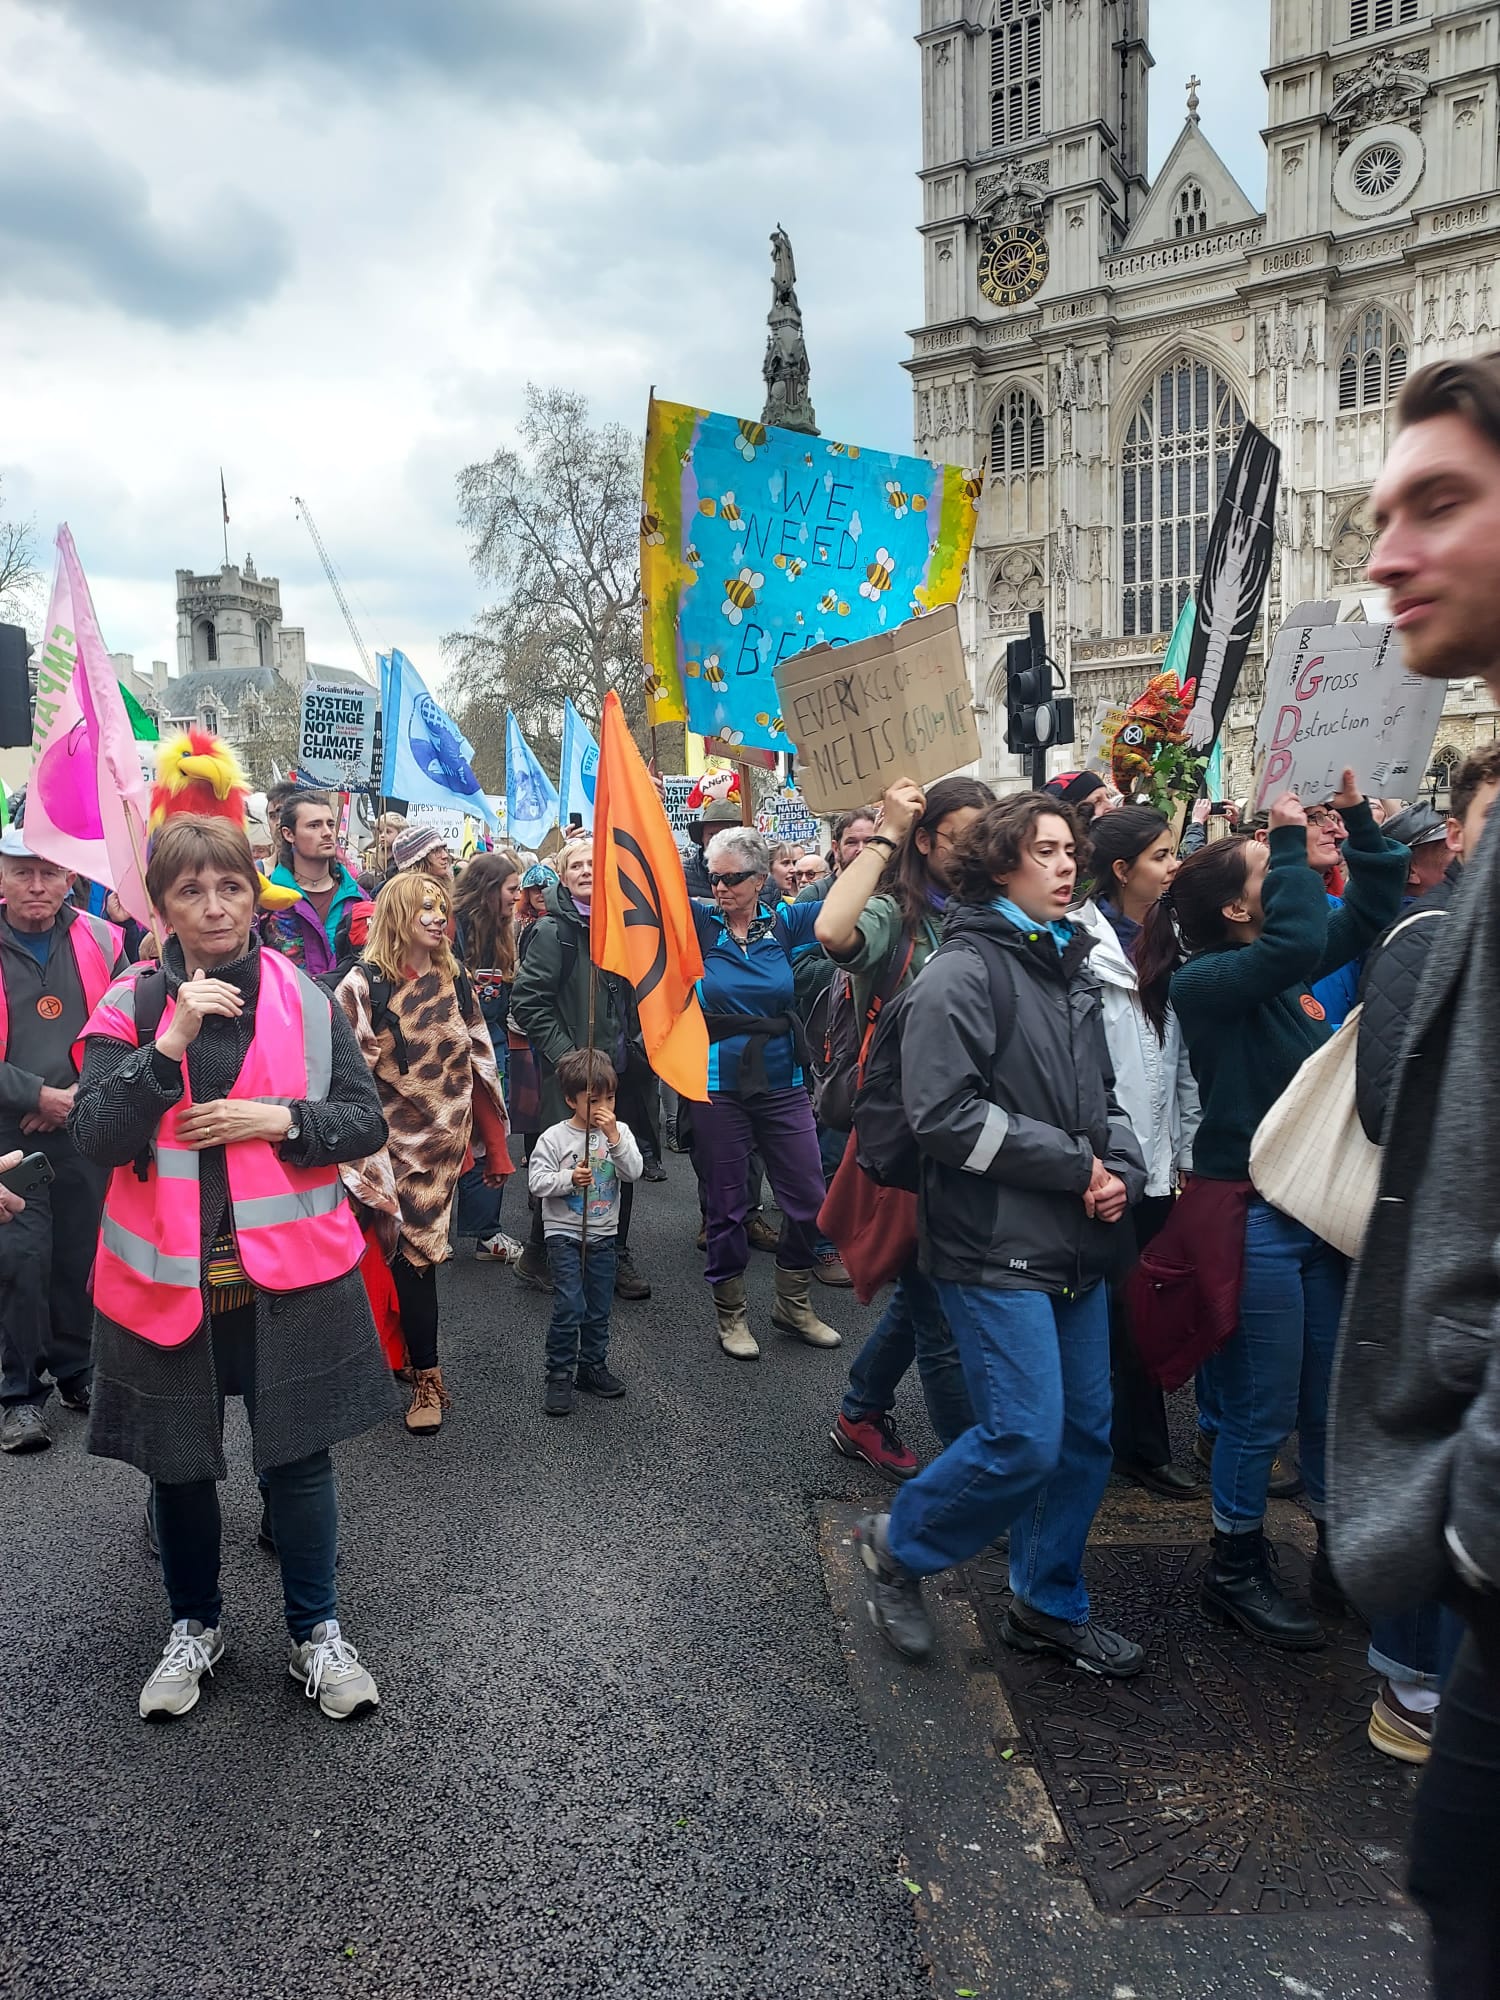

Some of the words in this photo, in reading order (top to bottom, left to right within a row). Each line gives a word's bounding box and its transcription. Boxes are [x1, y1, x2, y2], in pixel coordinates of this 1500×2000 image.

[783, 470, 854, 522] WE
[741, 513, 858, 570] NEED
[735, 623, 850, 677] BE
[894, 662, 912, 692] OF
[1295, 656, 1360, 701] Gross
[316, 685, 343, 695] Socialist
[343, 687, 365, 696] Worker
[305, 695, 363, 712] SYSTEM
[305, 708, 365, 725] CHANGE
[304, 721, 334, 734] NOT
[1270, 705, 1369, 751] Destruction
[1384, 705, 1406, 727] of
[303, 734, 364, 750] CLIMATE
[302, 746, 362, 761] CHANGE
[813, 717, 895, 796] MELTS
[702, 774, 733, 792] ANGRY
[1256, 749, 1336, 809] Planet
[779, 830, 813, 840] NATURE
[791, 822, 815, 831] NEED
[1009, 1259, 1027, 1269] HH
